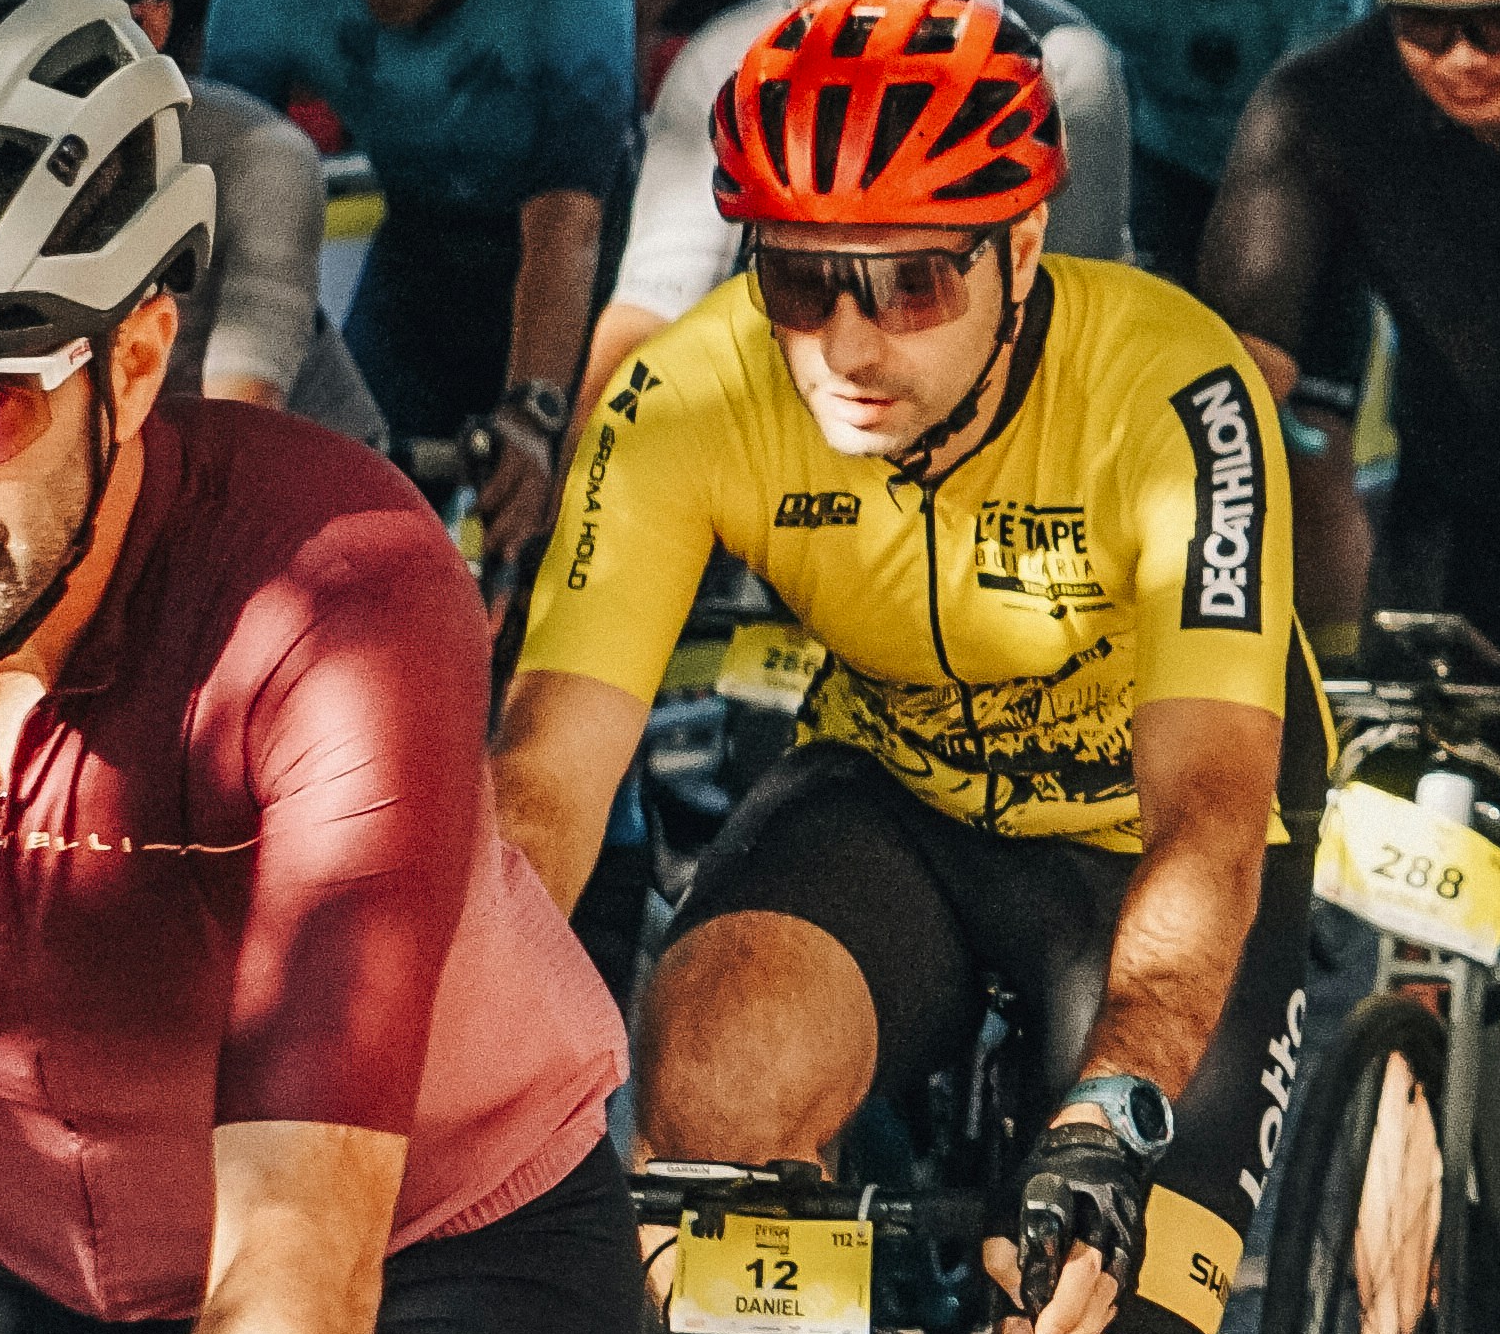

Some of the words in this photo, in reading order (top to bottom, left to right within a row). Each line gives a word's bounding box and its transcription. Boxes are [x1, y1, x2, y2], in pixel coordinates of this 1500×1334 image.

[1192, 379, 1255, 619] DECATHLON
[1371, 843, 1465, 900] 288
[831, 1232, 853, 1248] 112
[745, 1258, 799, 1291] 12
[735, 1296, 805, 1317] DANIEL
